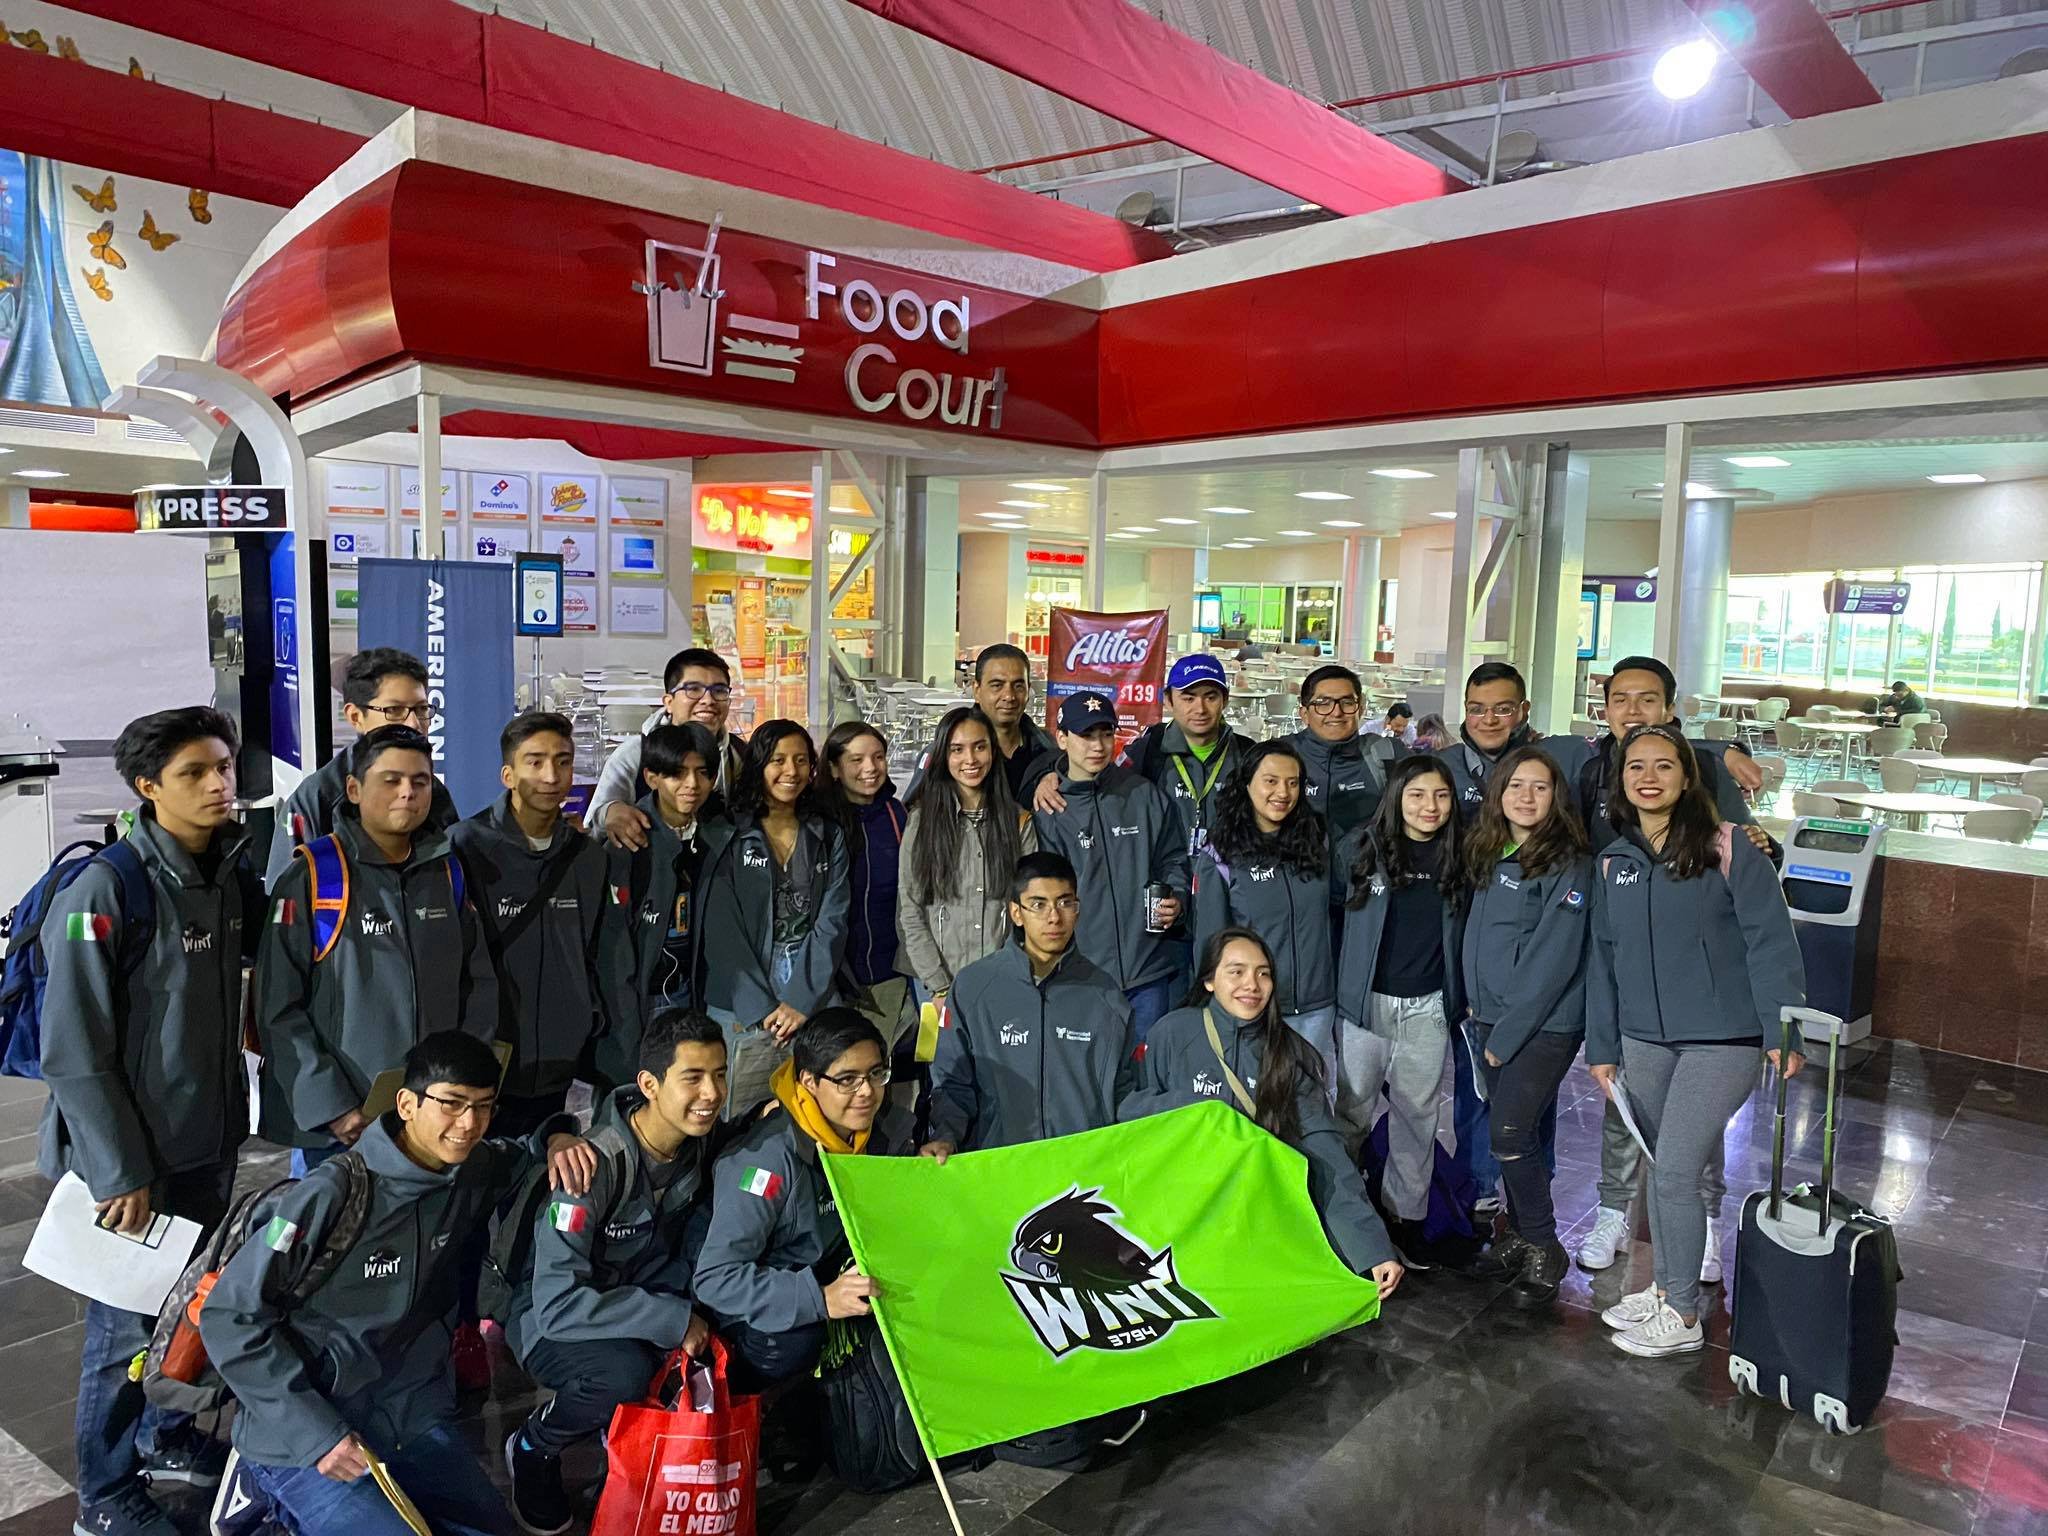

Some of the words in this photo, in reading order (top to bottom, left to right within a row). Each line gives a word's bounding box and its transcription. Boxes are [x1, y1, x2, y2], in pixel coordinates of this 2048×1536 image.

[806, 250, 970, 355] Food
[844, 343, 1008, 429] Court
[480, 500, 519, 510] Domino's
[828, 530, 871, 555] SUBWA
[1066, 628, 1149, 672] Alitas
[427, 578, 445, 761] AMERICAN
[1120, 684, 1155, 703] $139
[1175, 785, 1194, 799] WIN
[1250, 867, 1275, 882] WINT
[181, 932, 212, 953] WINT
[1000, 1030, 1030, 1045] WINT
[1193, 1079, 1223, 1096] WINT
[364, 1256, 402, 1279] WINT
[1003, 1252, 1198, 1352] WINT
[1107, 1325, 1158, 1348] 3794
[665, 1490, 691, 1512] YO
[695, 1487, 741, 1513] CUDO
[659, 1513, 681, 1534] EL
[685, 1510, 738, 1535] MEDIO
